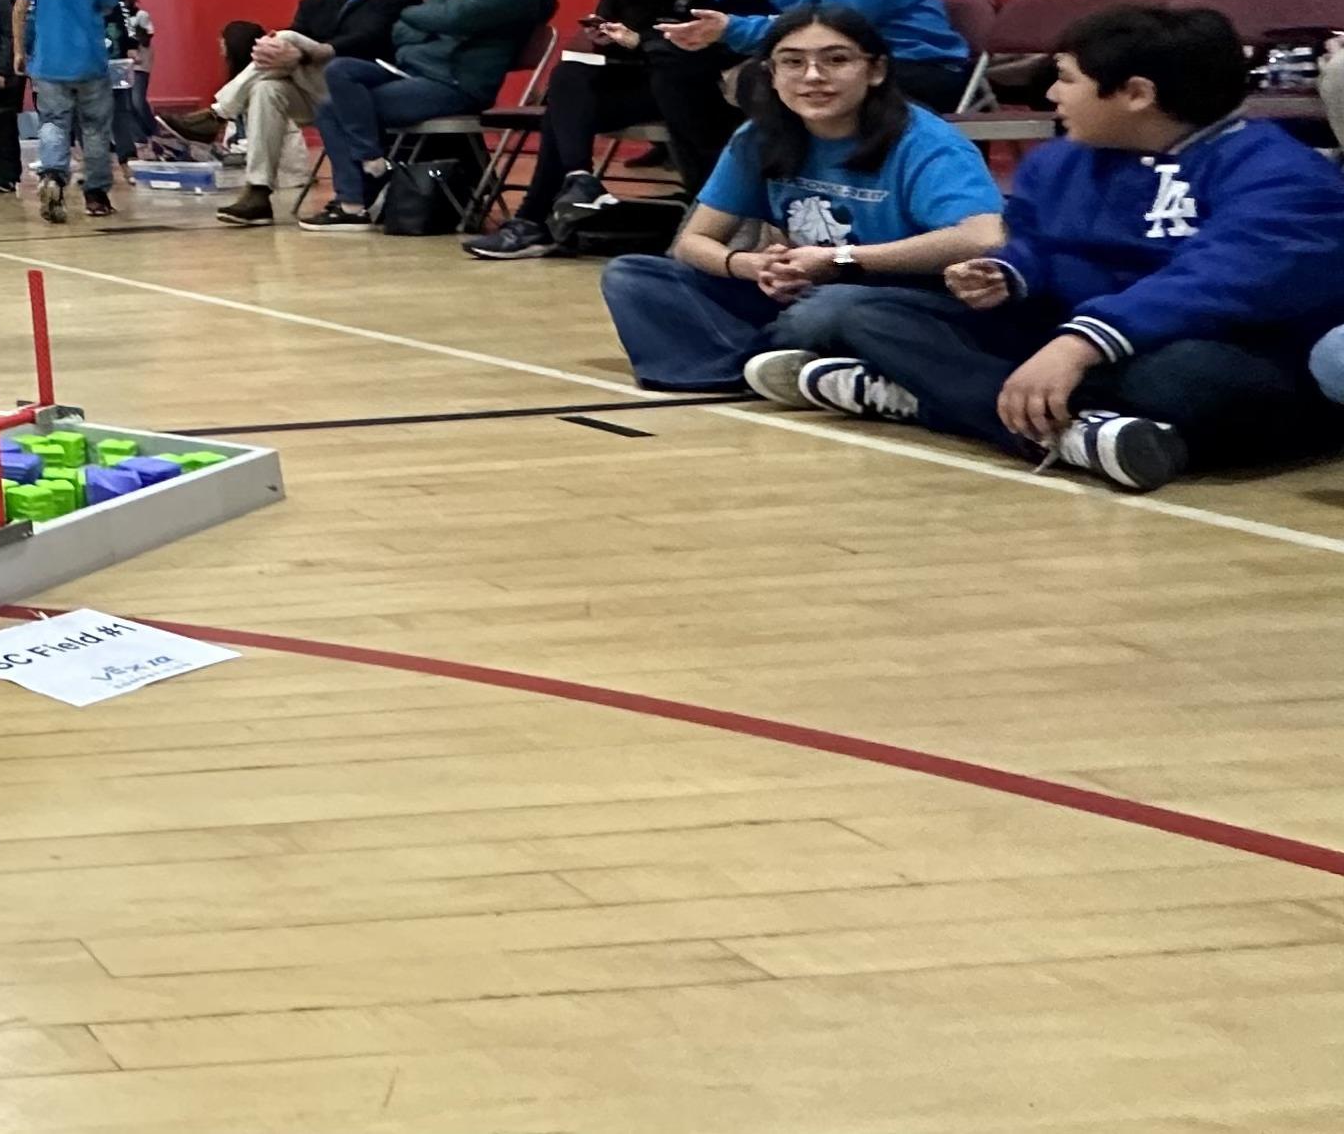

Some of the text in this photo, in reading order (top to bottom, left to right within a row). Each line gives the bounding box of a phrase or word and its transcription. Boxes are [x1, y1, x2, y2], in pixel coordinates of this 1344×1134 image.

[1143, 164, 1200, 238] LA
[27, 631, 104, 658] Field
[96, 622, 138, 637] #1
